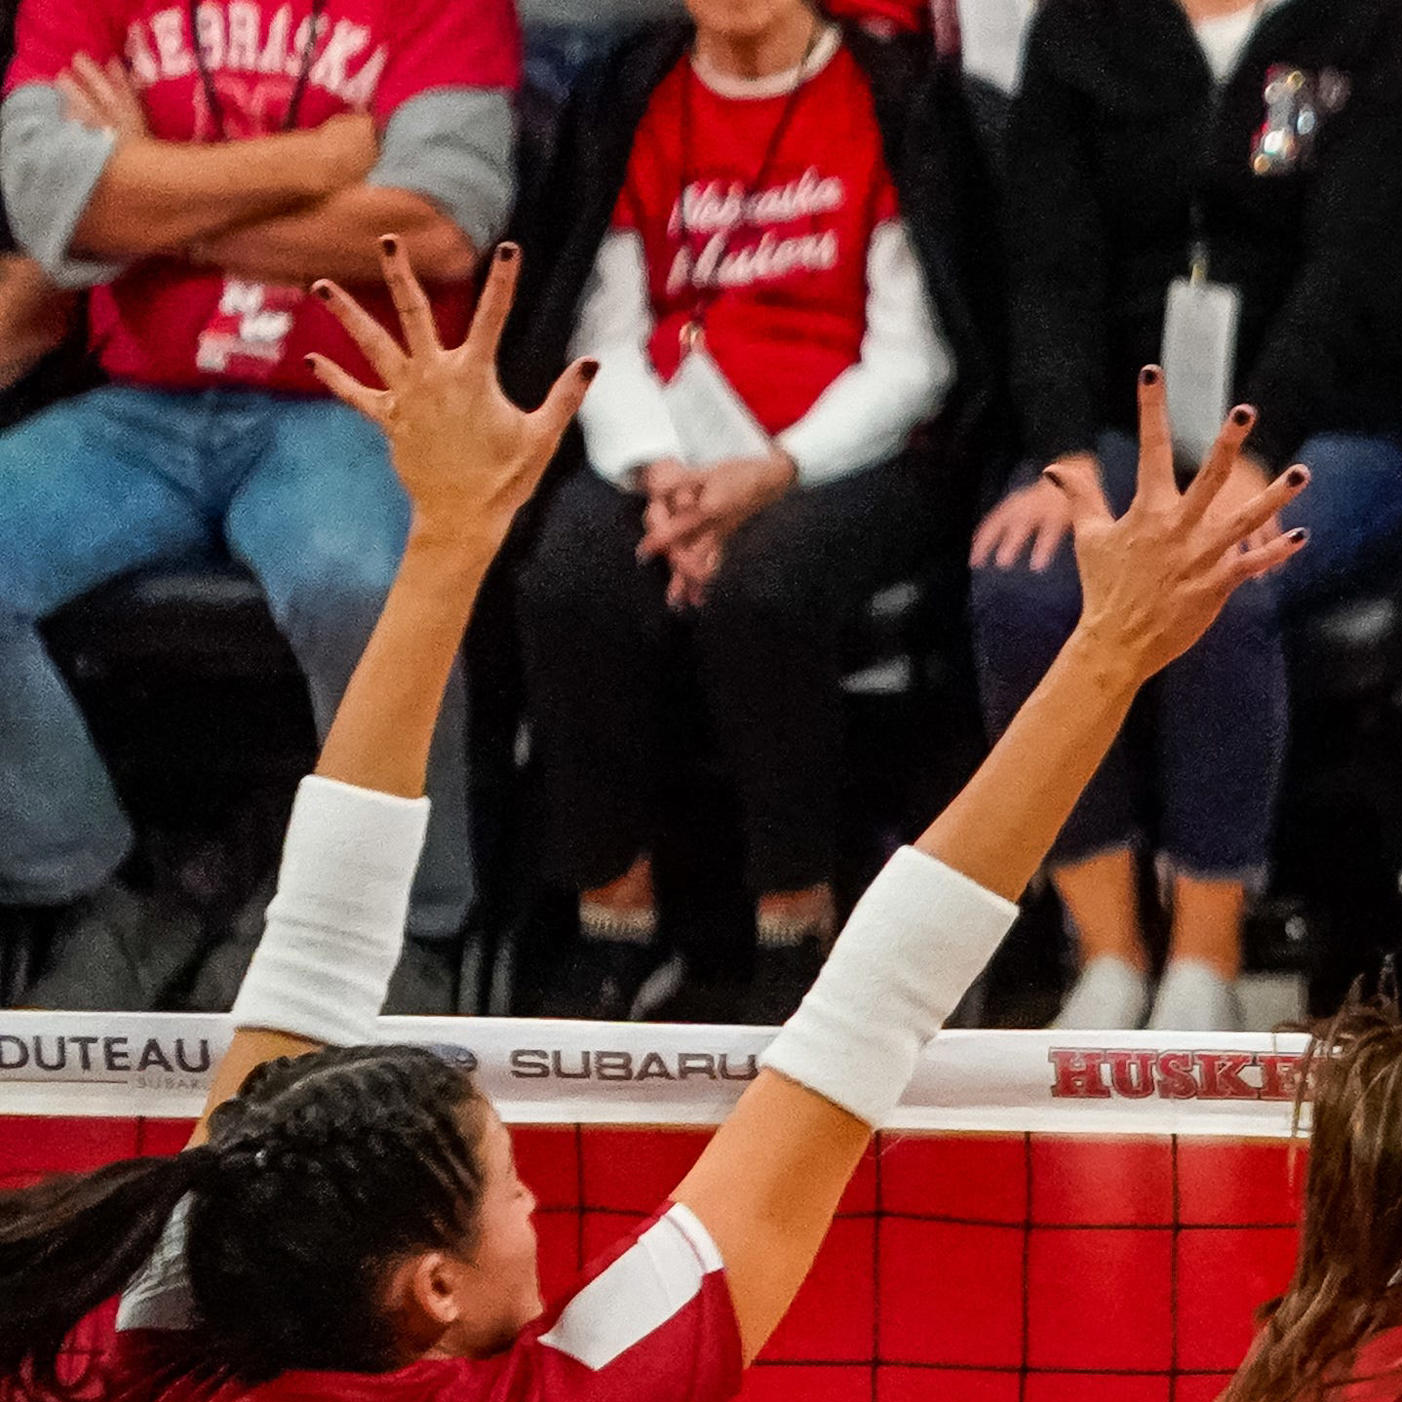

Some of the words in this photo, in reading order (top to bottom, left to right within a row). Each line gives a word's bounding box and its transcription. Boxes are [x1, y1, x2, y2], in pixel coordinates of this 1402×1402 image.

[0, 1035, 211, 1073] DUTEAU
[510, 1049, 760, 1081] SUBARU
[1049, 1047, 1312, 1101] HUSKE
